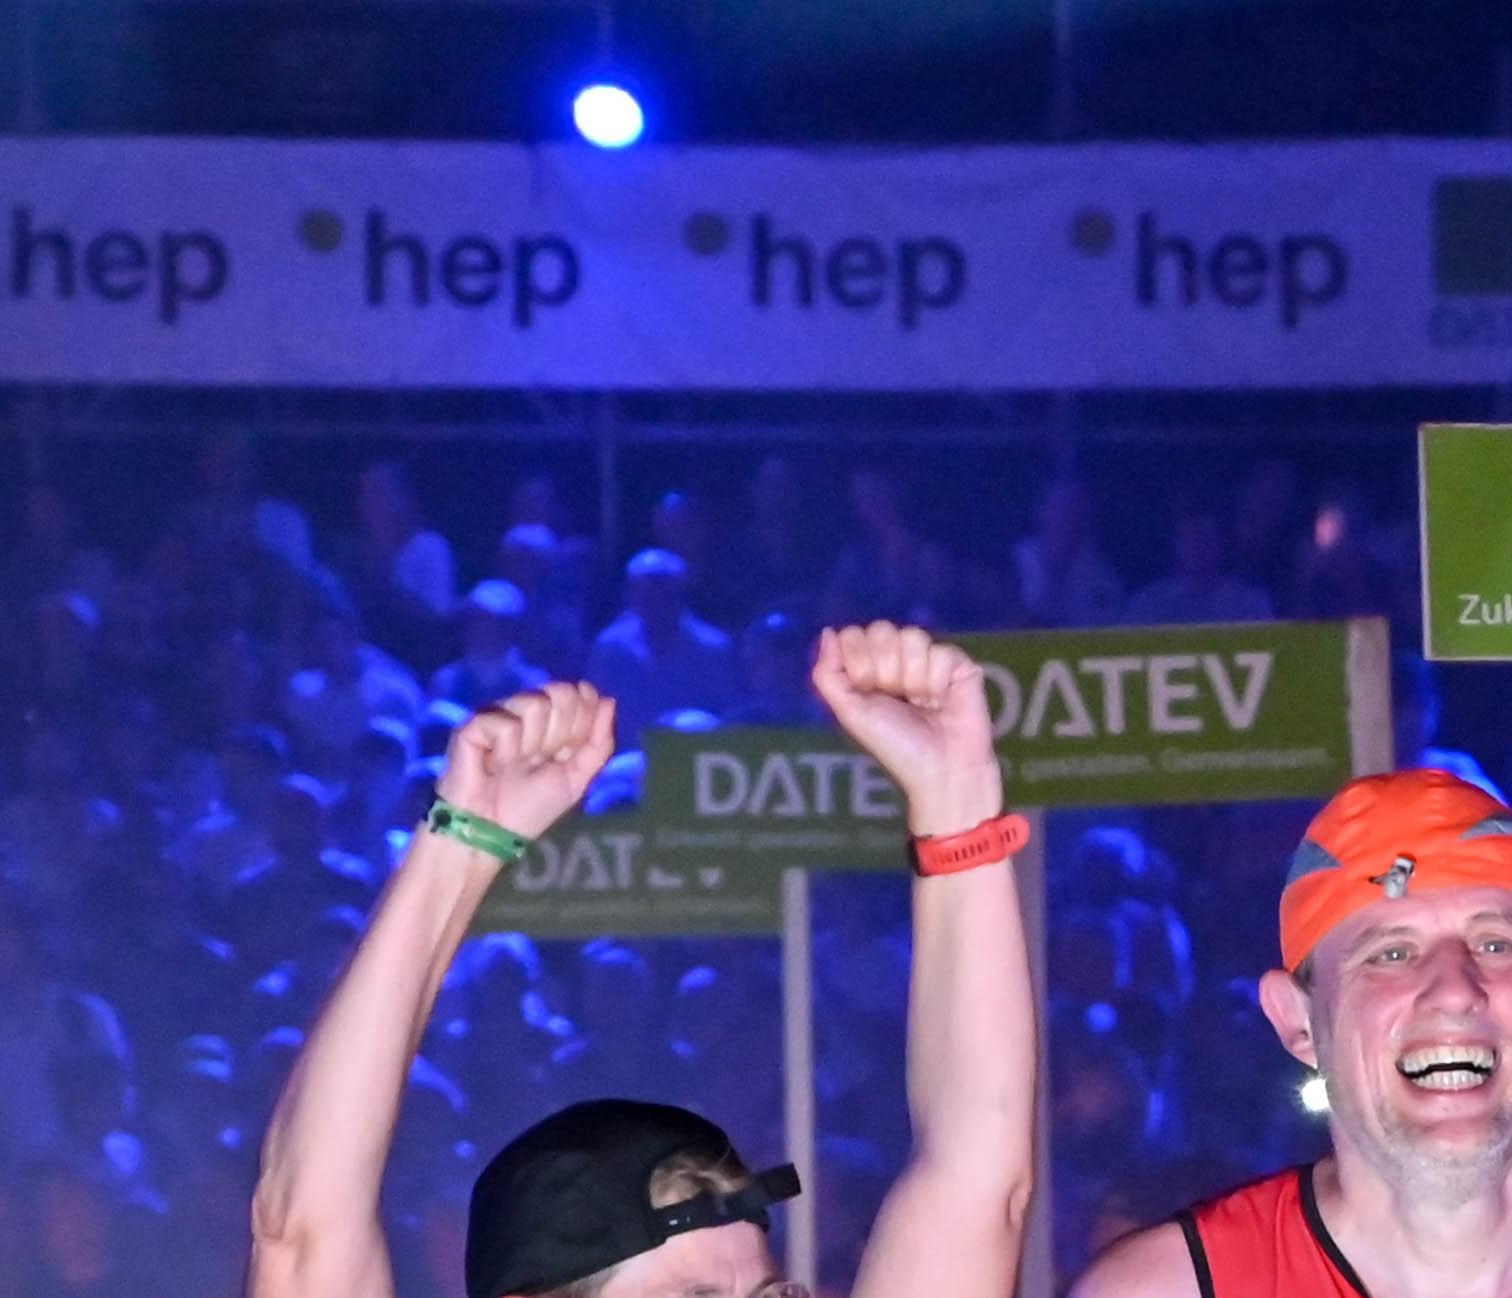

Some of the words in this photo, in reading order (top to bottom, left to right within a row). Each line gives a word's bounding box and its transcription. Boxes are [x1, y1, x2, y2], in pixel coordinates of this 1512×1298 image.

[10, 208, 230, 324] hep
[363, 208, 583, 327] hep
[748, 210, 967, 328] hep
[1133, 211, 1350, 328] hep
[694, 750, 900, 818] DATE
